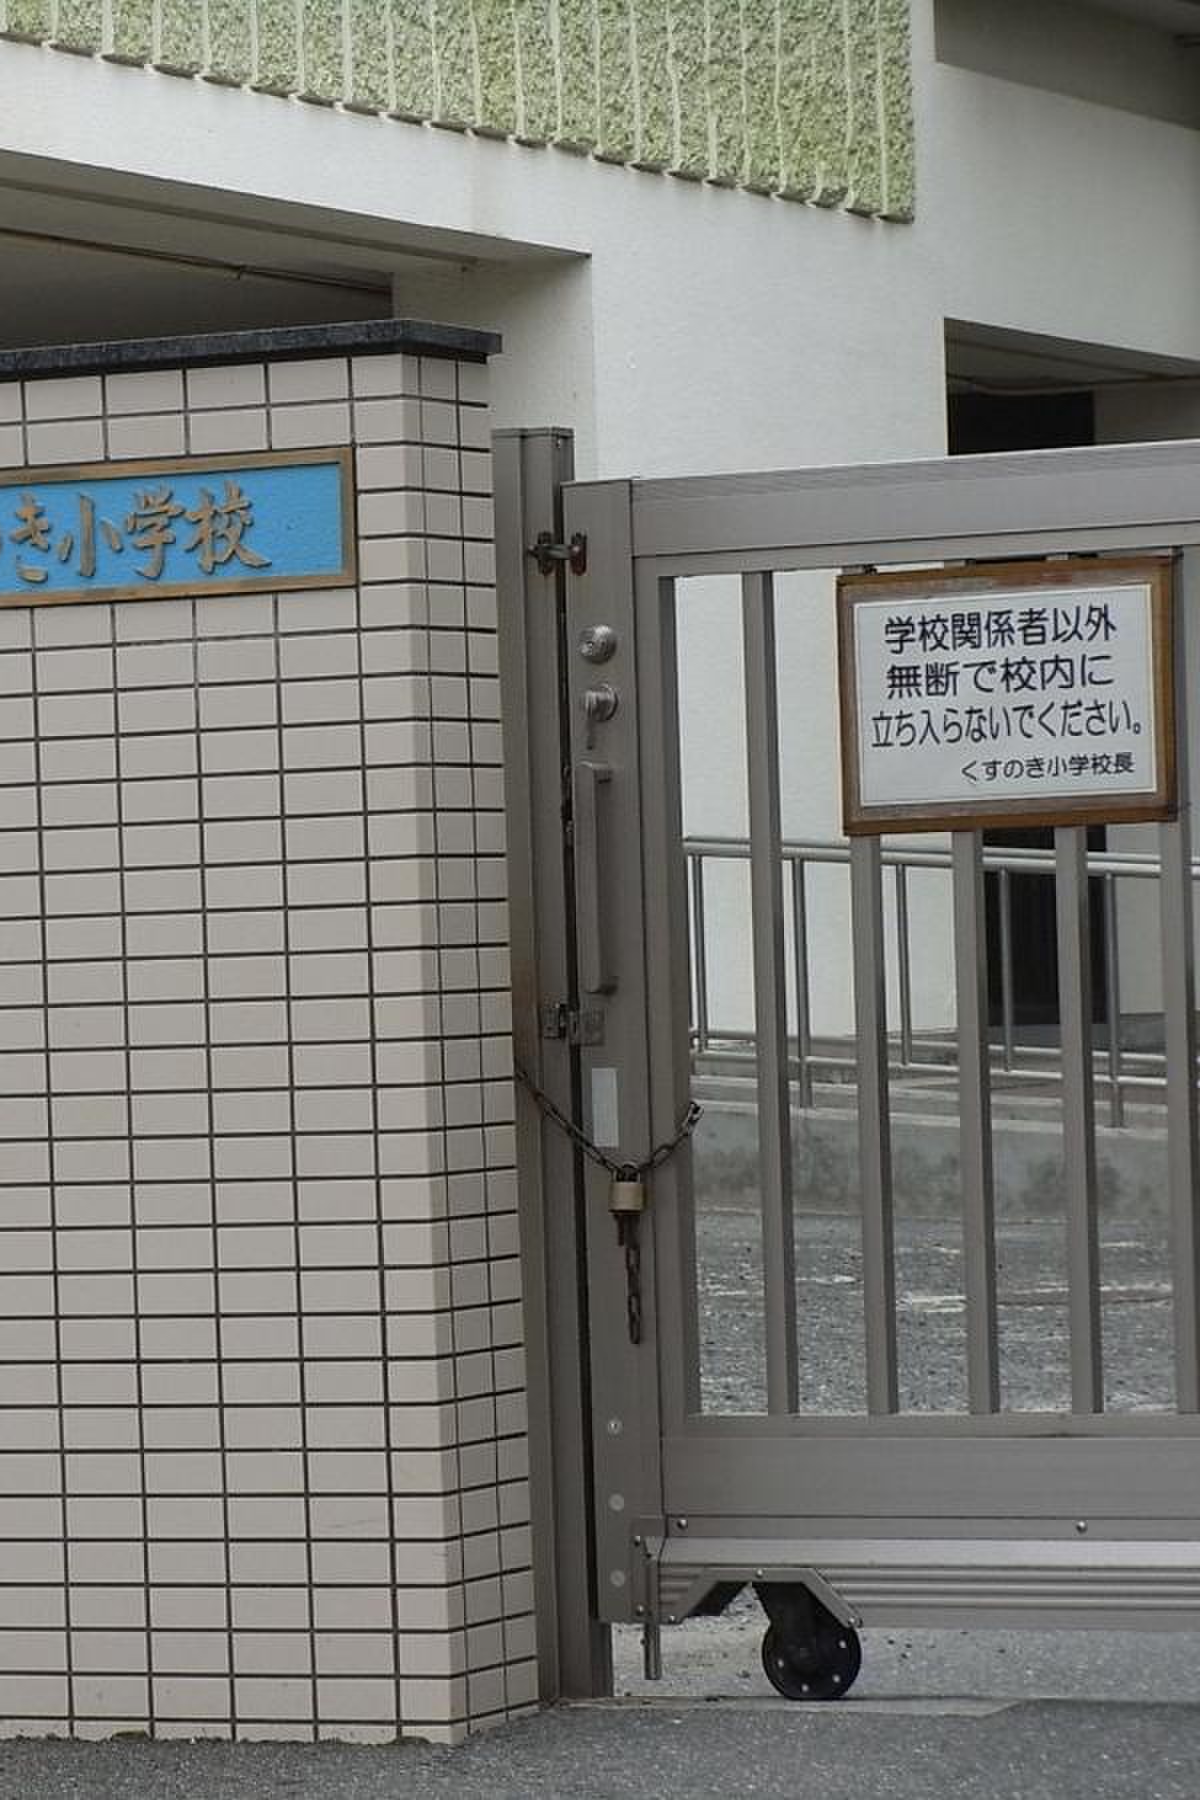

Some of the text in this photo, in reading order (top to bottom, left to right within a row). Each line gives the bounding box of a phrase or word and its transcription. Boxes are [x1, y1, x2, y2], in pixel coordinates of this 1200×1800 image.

[885, 604, 1117, 654] 学校関係者以外
[886, 653, 1114, 699] 無断で校内に
[871, 699, 1142, 748] 立ち入らないでください。
[961, 752, 1135, 782] くすのき小学校長
